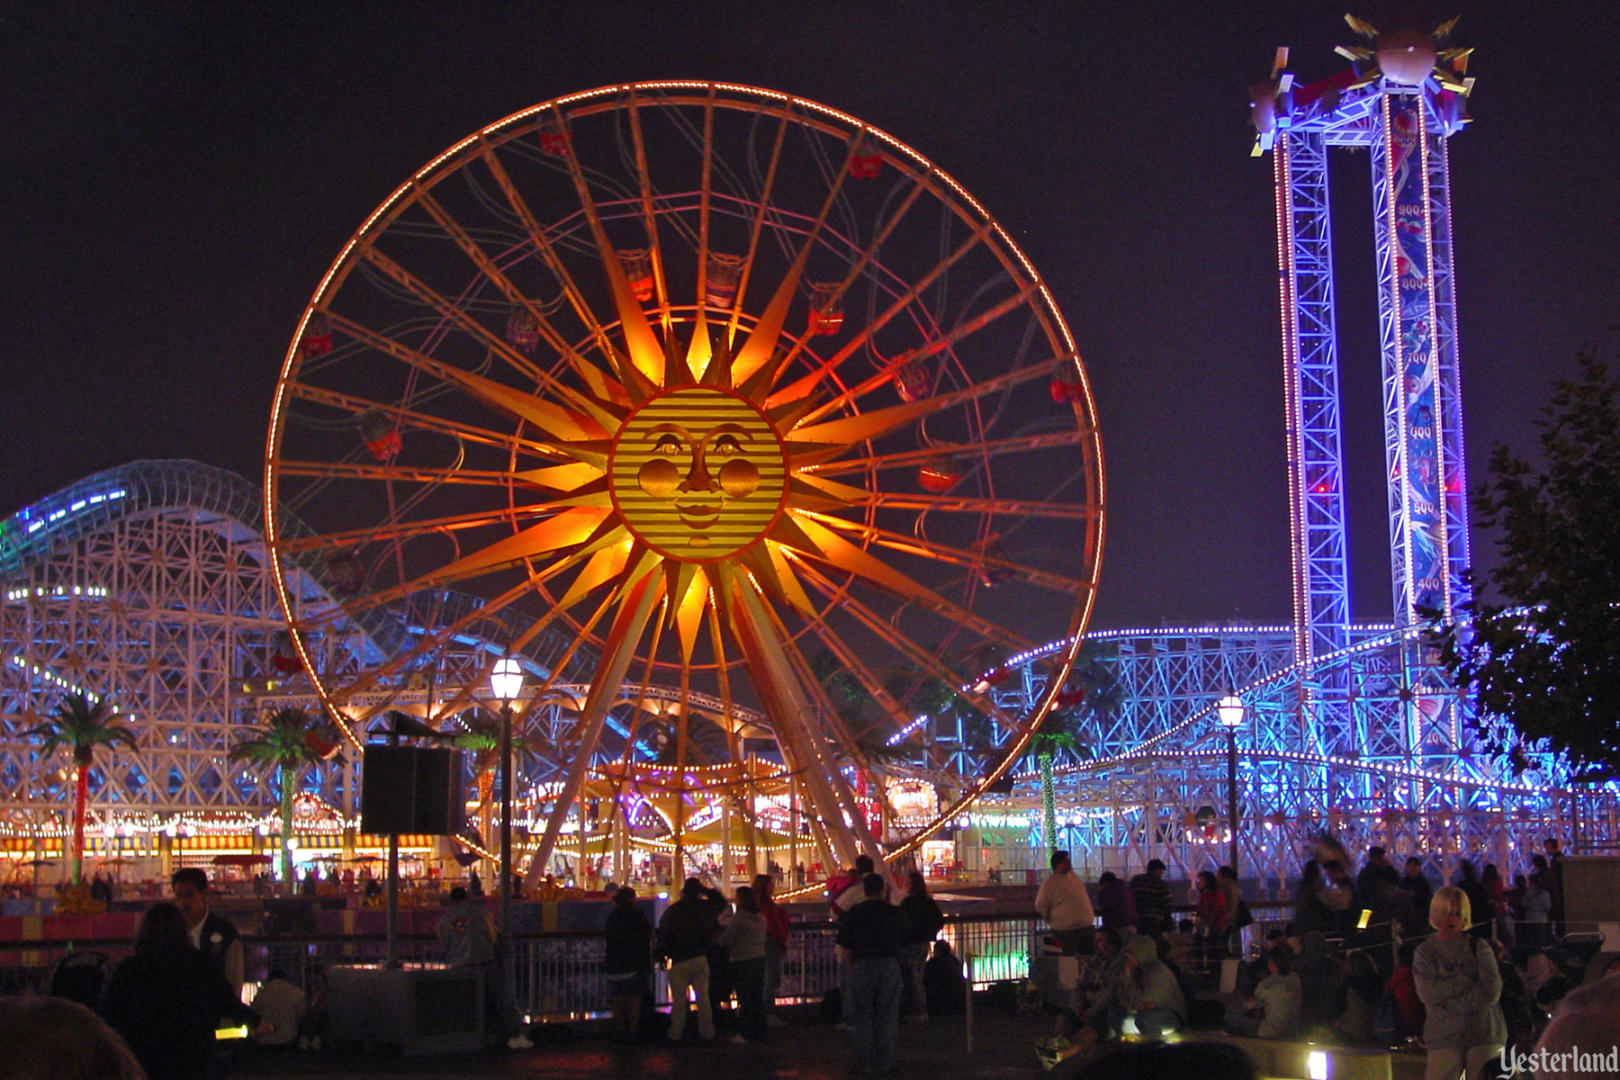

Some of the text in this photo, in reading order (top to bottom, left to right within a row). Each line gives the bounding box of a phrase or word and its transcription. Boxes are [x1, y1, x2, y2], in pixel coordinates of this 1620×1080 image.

[1399, 204, 1420, 216] 900
[1408, 352, 1427, 364] 700
[1414, 502, 1435, 514] 500
[1418, 578, 1439, 590] 400
